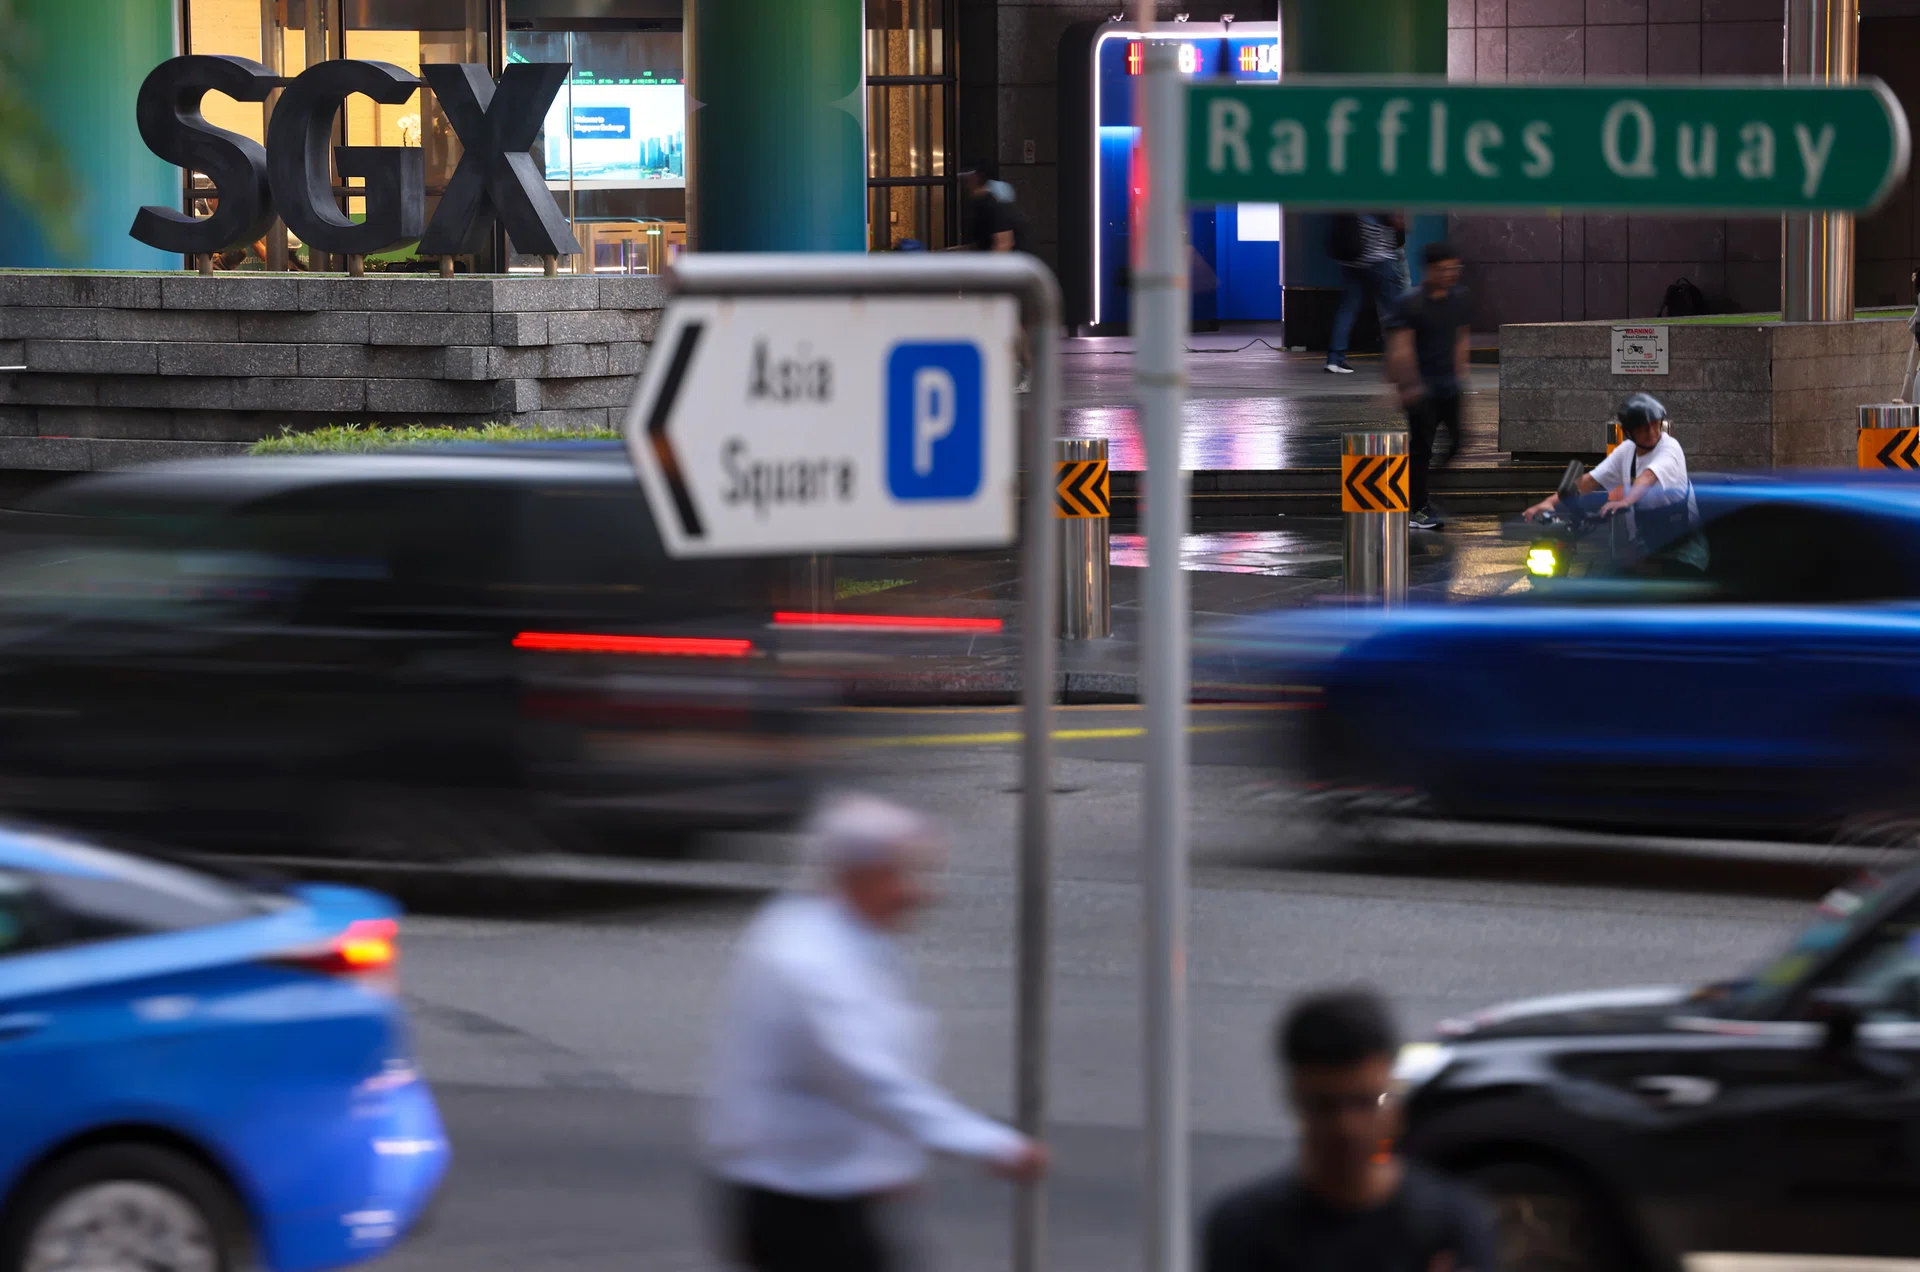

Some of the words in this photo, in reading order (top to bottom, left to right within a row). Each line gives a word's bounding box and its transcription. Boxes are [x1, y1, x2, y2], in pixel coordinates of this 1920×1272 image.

[129, 55, 583, 254] SGX
[1206, 97, 1555, 178] Raffles
[1601, 99, 1836, 199] Quay
[747, 337, 834, 403] Asia
[911, 367, 958, 477] P
[720, 436, 857, 520] Square
